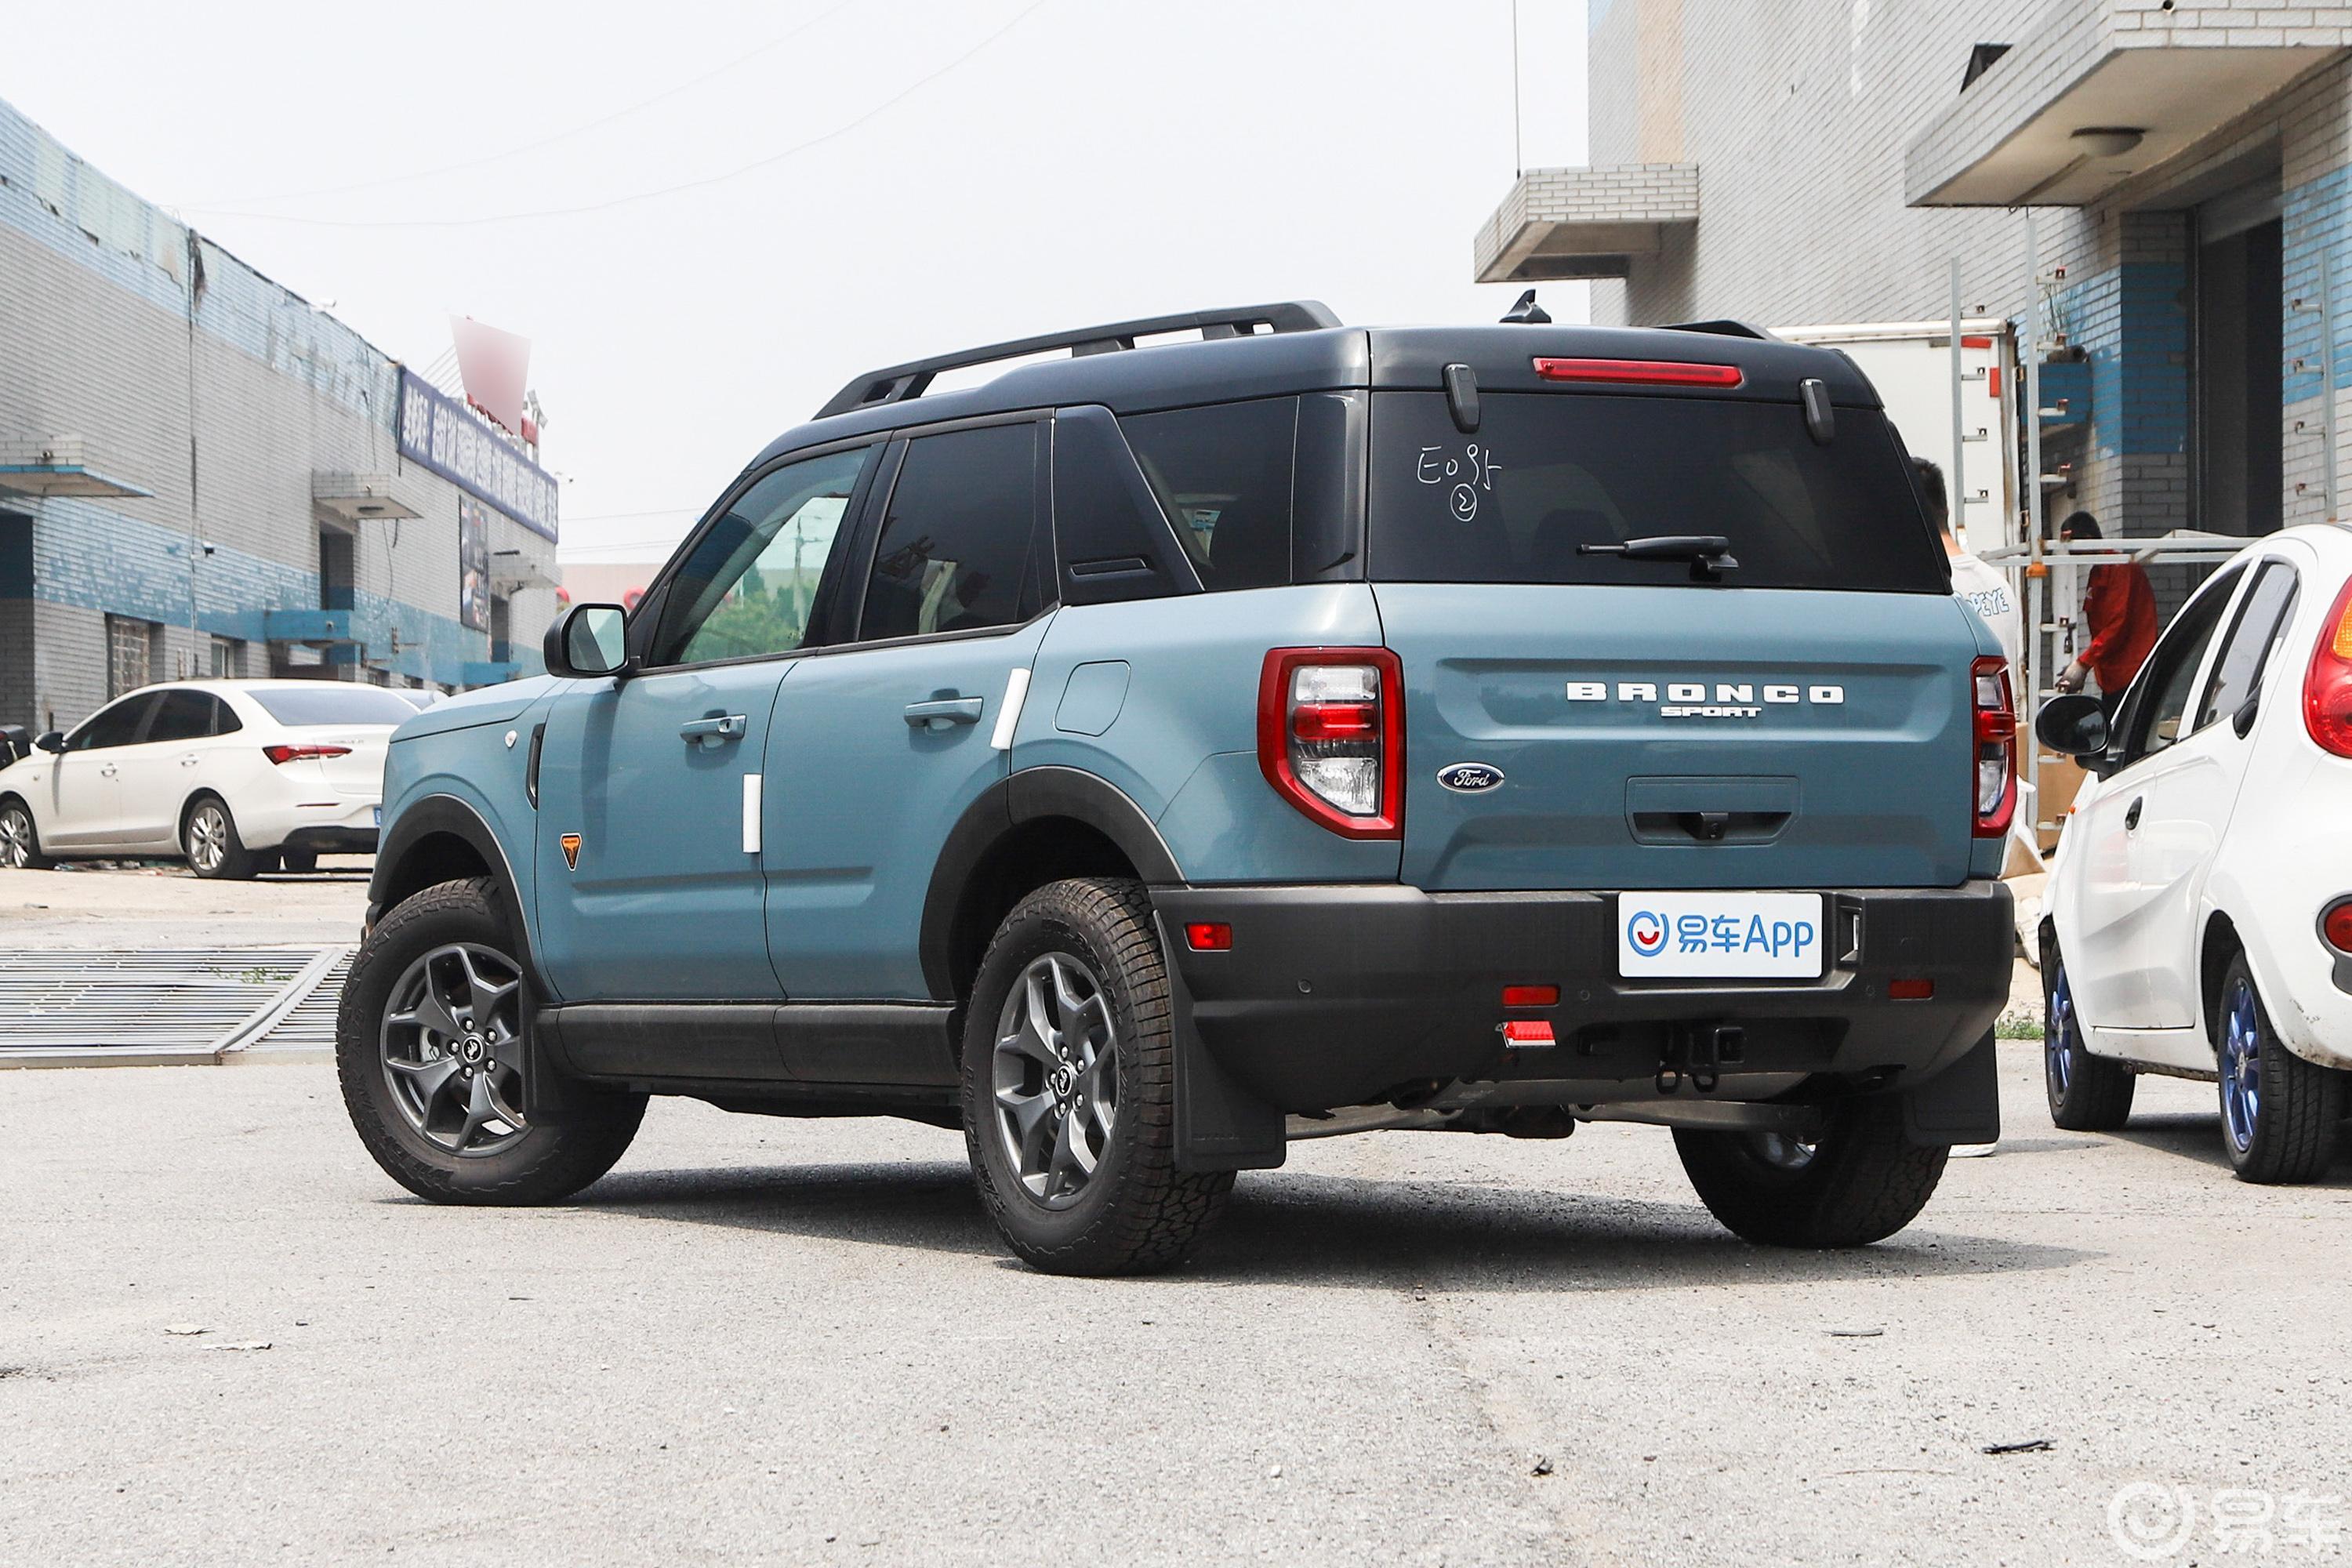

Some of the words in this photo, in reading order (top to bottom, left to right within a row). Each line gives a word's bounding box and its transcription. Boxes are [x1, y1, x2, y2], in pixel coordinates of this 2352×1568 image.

[1566, 681, 1845, 704] BRONCO
[1660, 706, 1762, 718] SPORT
[1454, 768, 1490, 786] Ford
